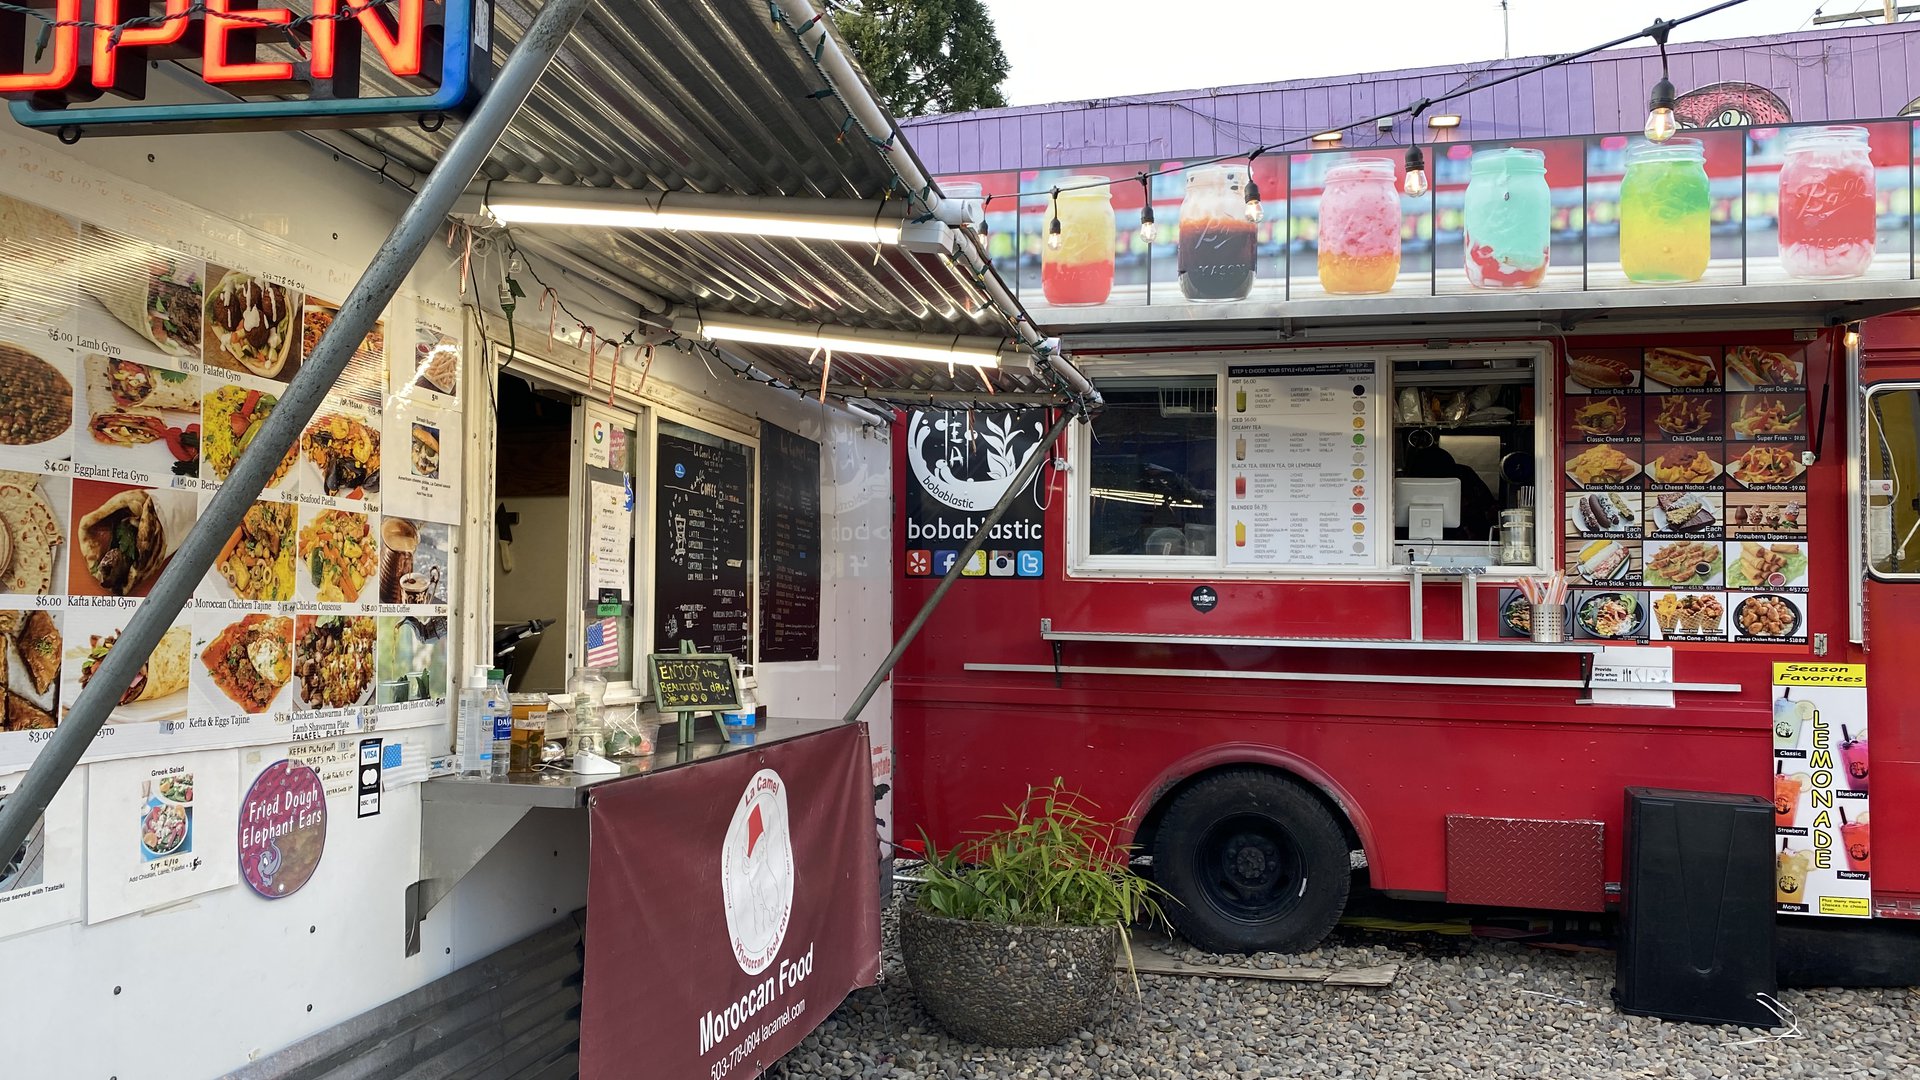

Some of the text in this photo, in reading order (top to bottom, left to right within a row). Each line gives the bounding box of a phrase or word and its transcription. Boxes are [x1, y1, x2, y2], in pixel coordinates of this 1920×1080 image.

[77, 336, 121, 355] Lamb Gyro
[203, 365, 241, 383] Falafel Gyro
[1593, 387, 1612, 395] Classic
[1613, 387, 1625, 395] Dog
[1758, 386, 1788, 394] Super Dog
[1757, 434, 1773, 442] Super
[74, 463, 149, 483] Eggplant Feta Gyro
[922, 475, 975, 509] bobablastic
[1750, 484, 1765, 492] Super
[300, 494, 336, 507] Seafood Paella
[907, 517, 1042, 540] bobabastic
[1604, 532, 1625, 540] Dippers
[36, 595, 62, 606] $6.00
[67, 596, 137, 608] Kafta Kebab Gyro
[195, 599, 227, 609] Moroccan
[228, 600, 251, 610] Chicken
[253, 601, 271, 611] Tajine
[296, 602, 342, 611] Chicken Couscous
[379, 604, 411, 613] Turkish Coffee
[659, 664, 719, 680] ENJOY the
[1786, 664, 1849, 673] Season
[1779, 673, 1863, 682] Favorites
[660, 681, 726, 696] BEAUTIFUL day
[377, 704, 400, 713] Moroccan
[400, 702, 408, 710] Tea
[292, 708, 356, 721] Chicken Shawarma Plate
[189, 715, 250, 728] Kefta & Eggs Tajine
[292, 720, 350, 733] Lamb Shawarma Plate
[326, 729, 346, 738] PLATE
[365, 750, 377, 759] VISA
[151, 765, 185, 777] Greek Salad
[745, 776, 780, 807] La Camel
[1809, 709, 1834, 869] LEMONADE
[1838, 791, 1867, 799] Blueberry
[250, 783, 319, 823] Fried Dough
[242, 809, 322, 849] Elephant Ears
[1777, 827, 1807, 835] Strawberry
[129, 875, 138, 883] Add
[12, 883, 66, 900] served with Tzatziki
[766, 932, 781, 962] food
[699, 941, 814, 1057] Moroccan Food
[710, 998, 806, 1080] 503-778-0604 lacamel.com
